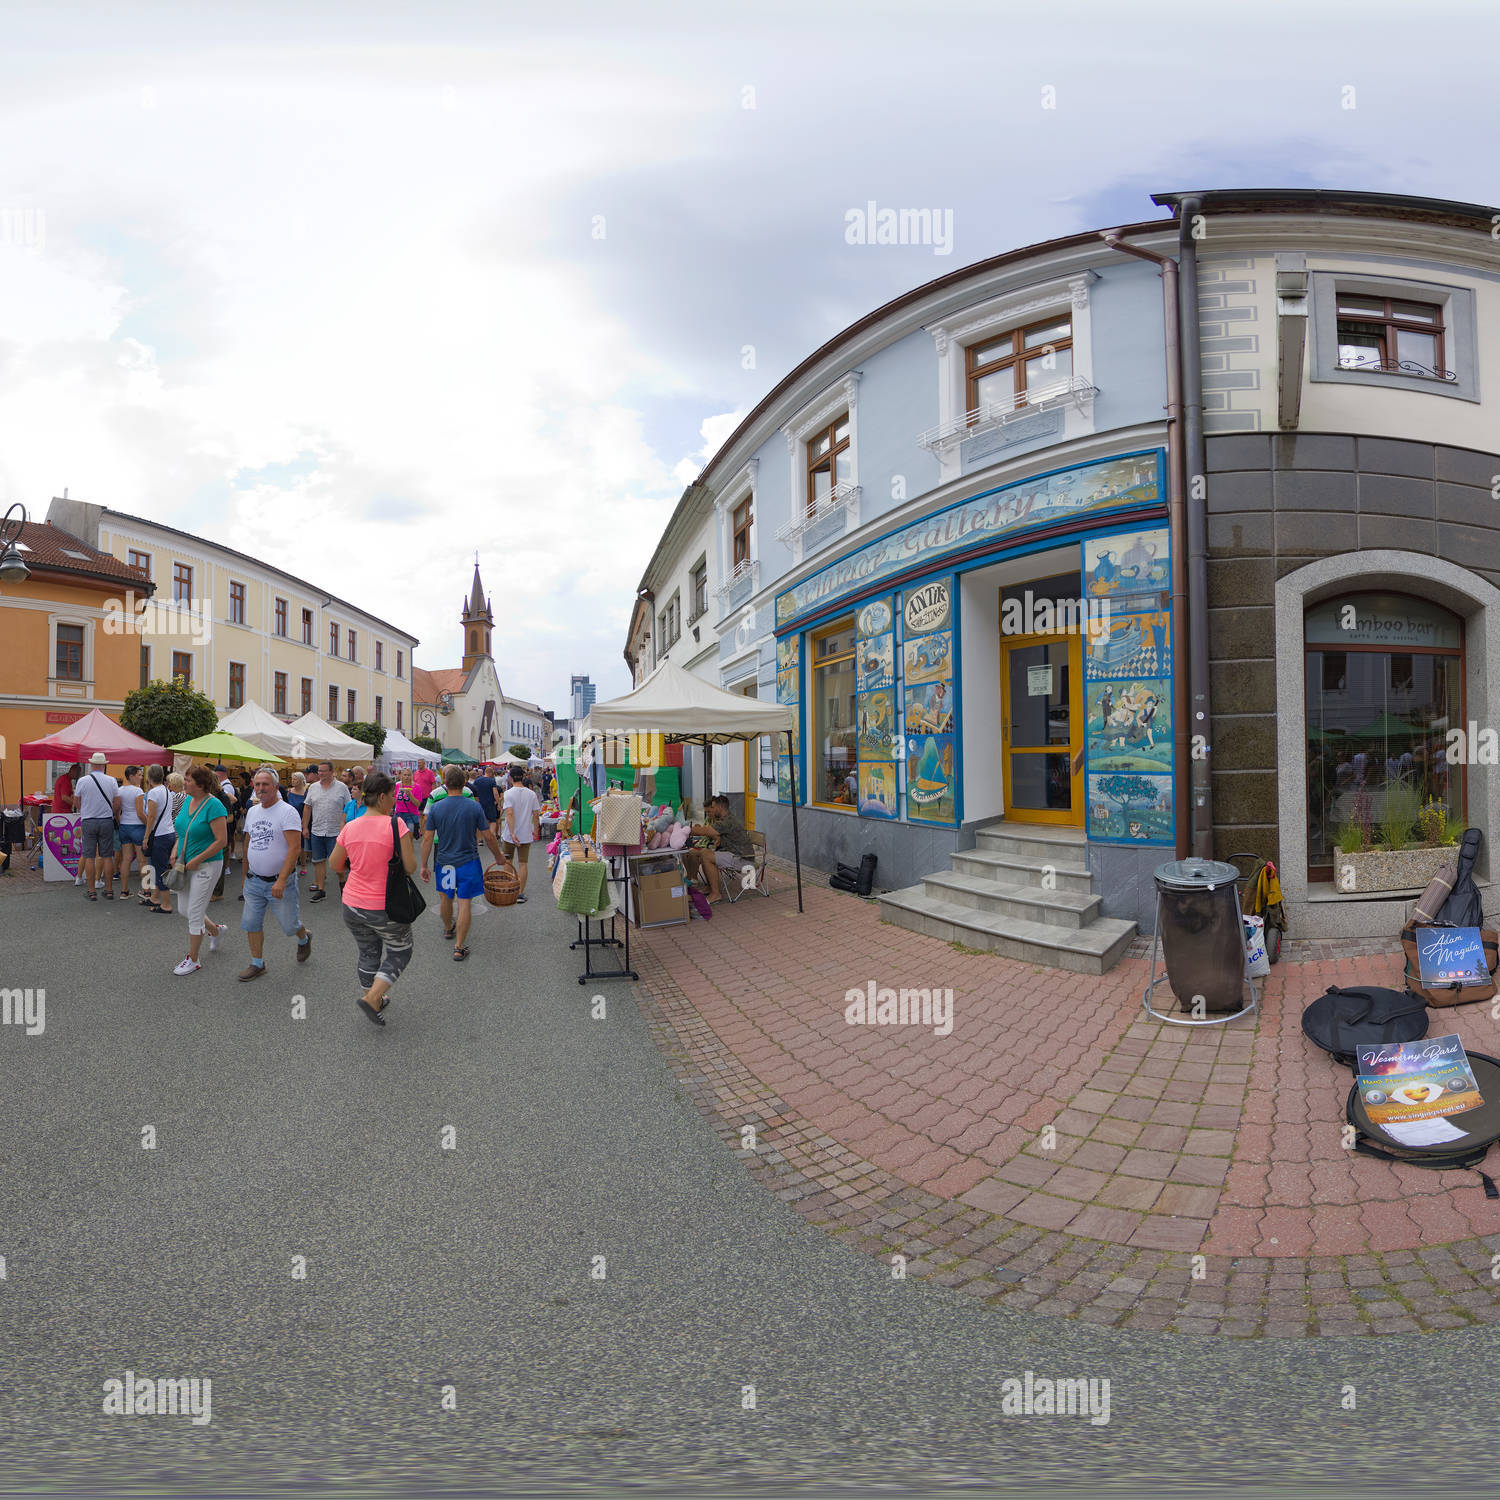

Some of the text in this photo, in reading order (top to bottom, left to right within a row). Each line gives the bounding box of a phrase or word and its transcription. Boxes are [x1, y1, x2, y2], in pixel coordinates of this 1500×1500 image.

[903, 491, 1038, 558] Gallery
[1407, 616, 1433, 634] bar
[1422, 932, 1463, 954] Adam
[1429, 942, 1480, 965] Magula
[1422, 1044, 1458, 1061] Bard
[1387, 1104, 1466, 1121] www.singingsteel.eu
